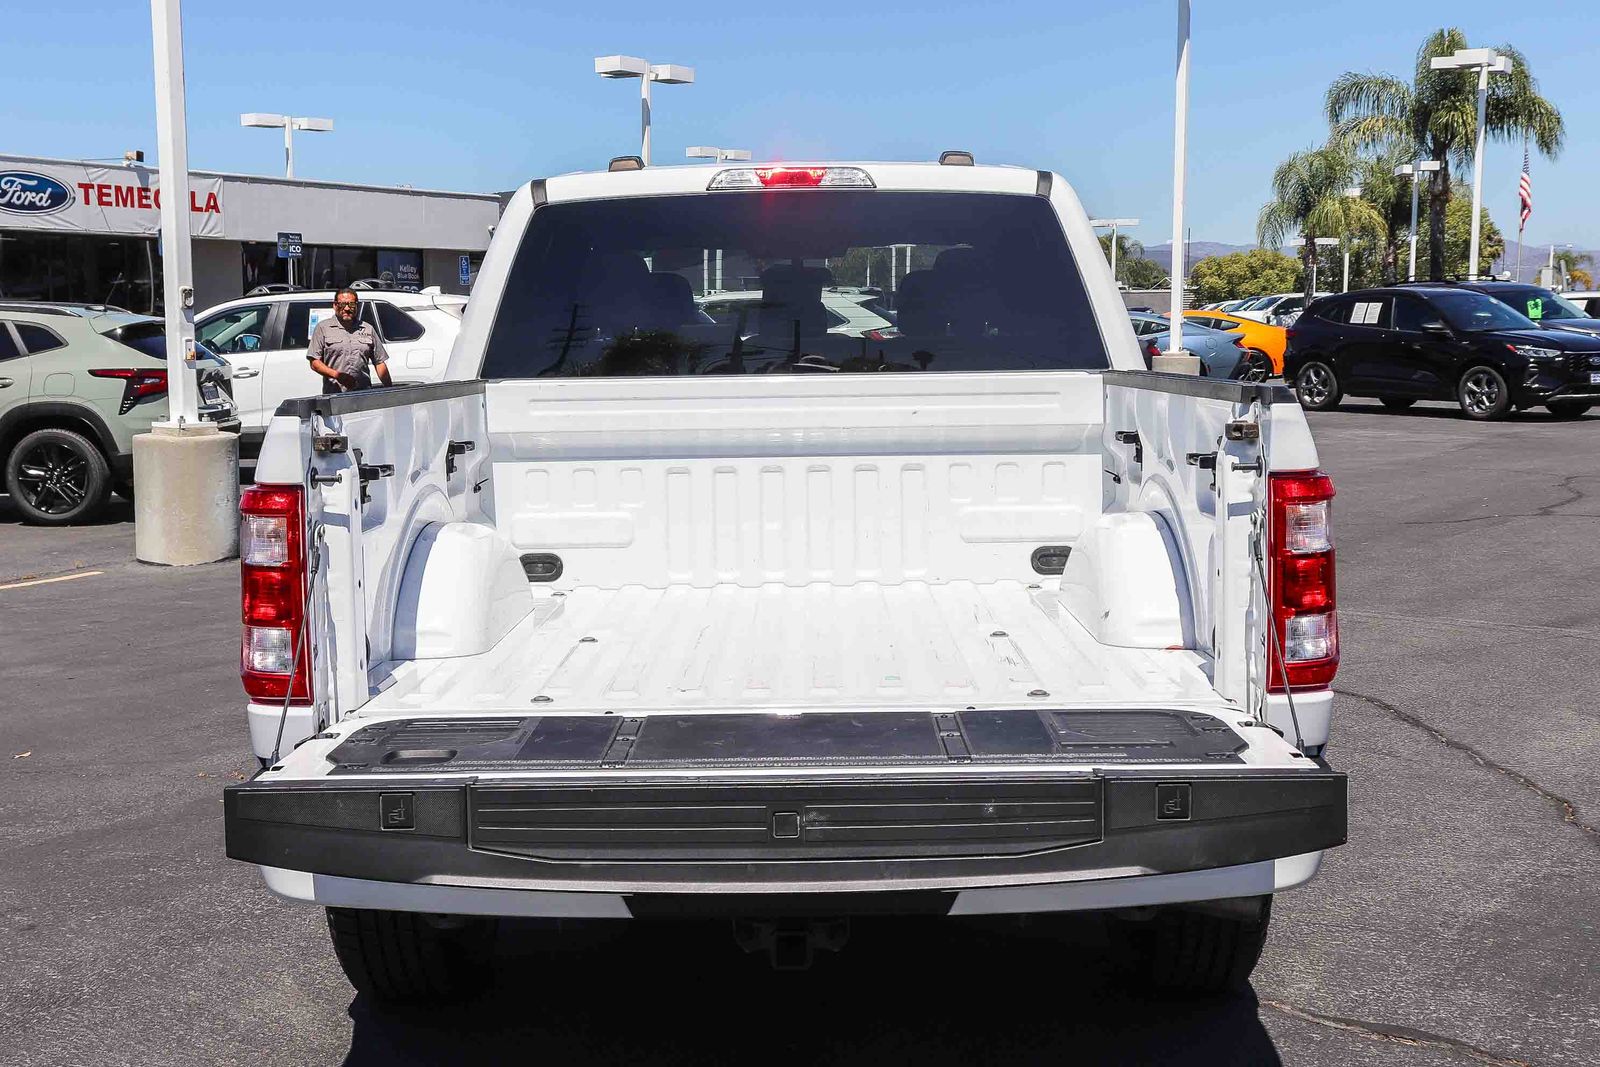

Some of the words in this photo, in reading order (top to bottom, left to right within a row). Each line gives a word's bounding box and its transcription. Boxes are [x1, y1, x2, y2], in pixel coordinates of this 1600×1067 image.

[0, 176, 52, 207] Ford
[77, 182, 221, 213] TEMELA
[399, 264, 417, 273] Kelley
